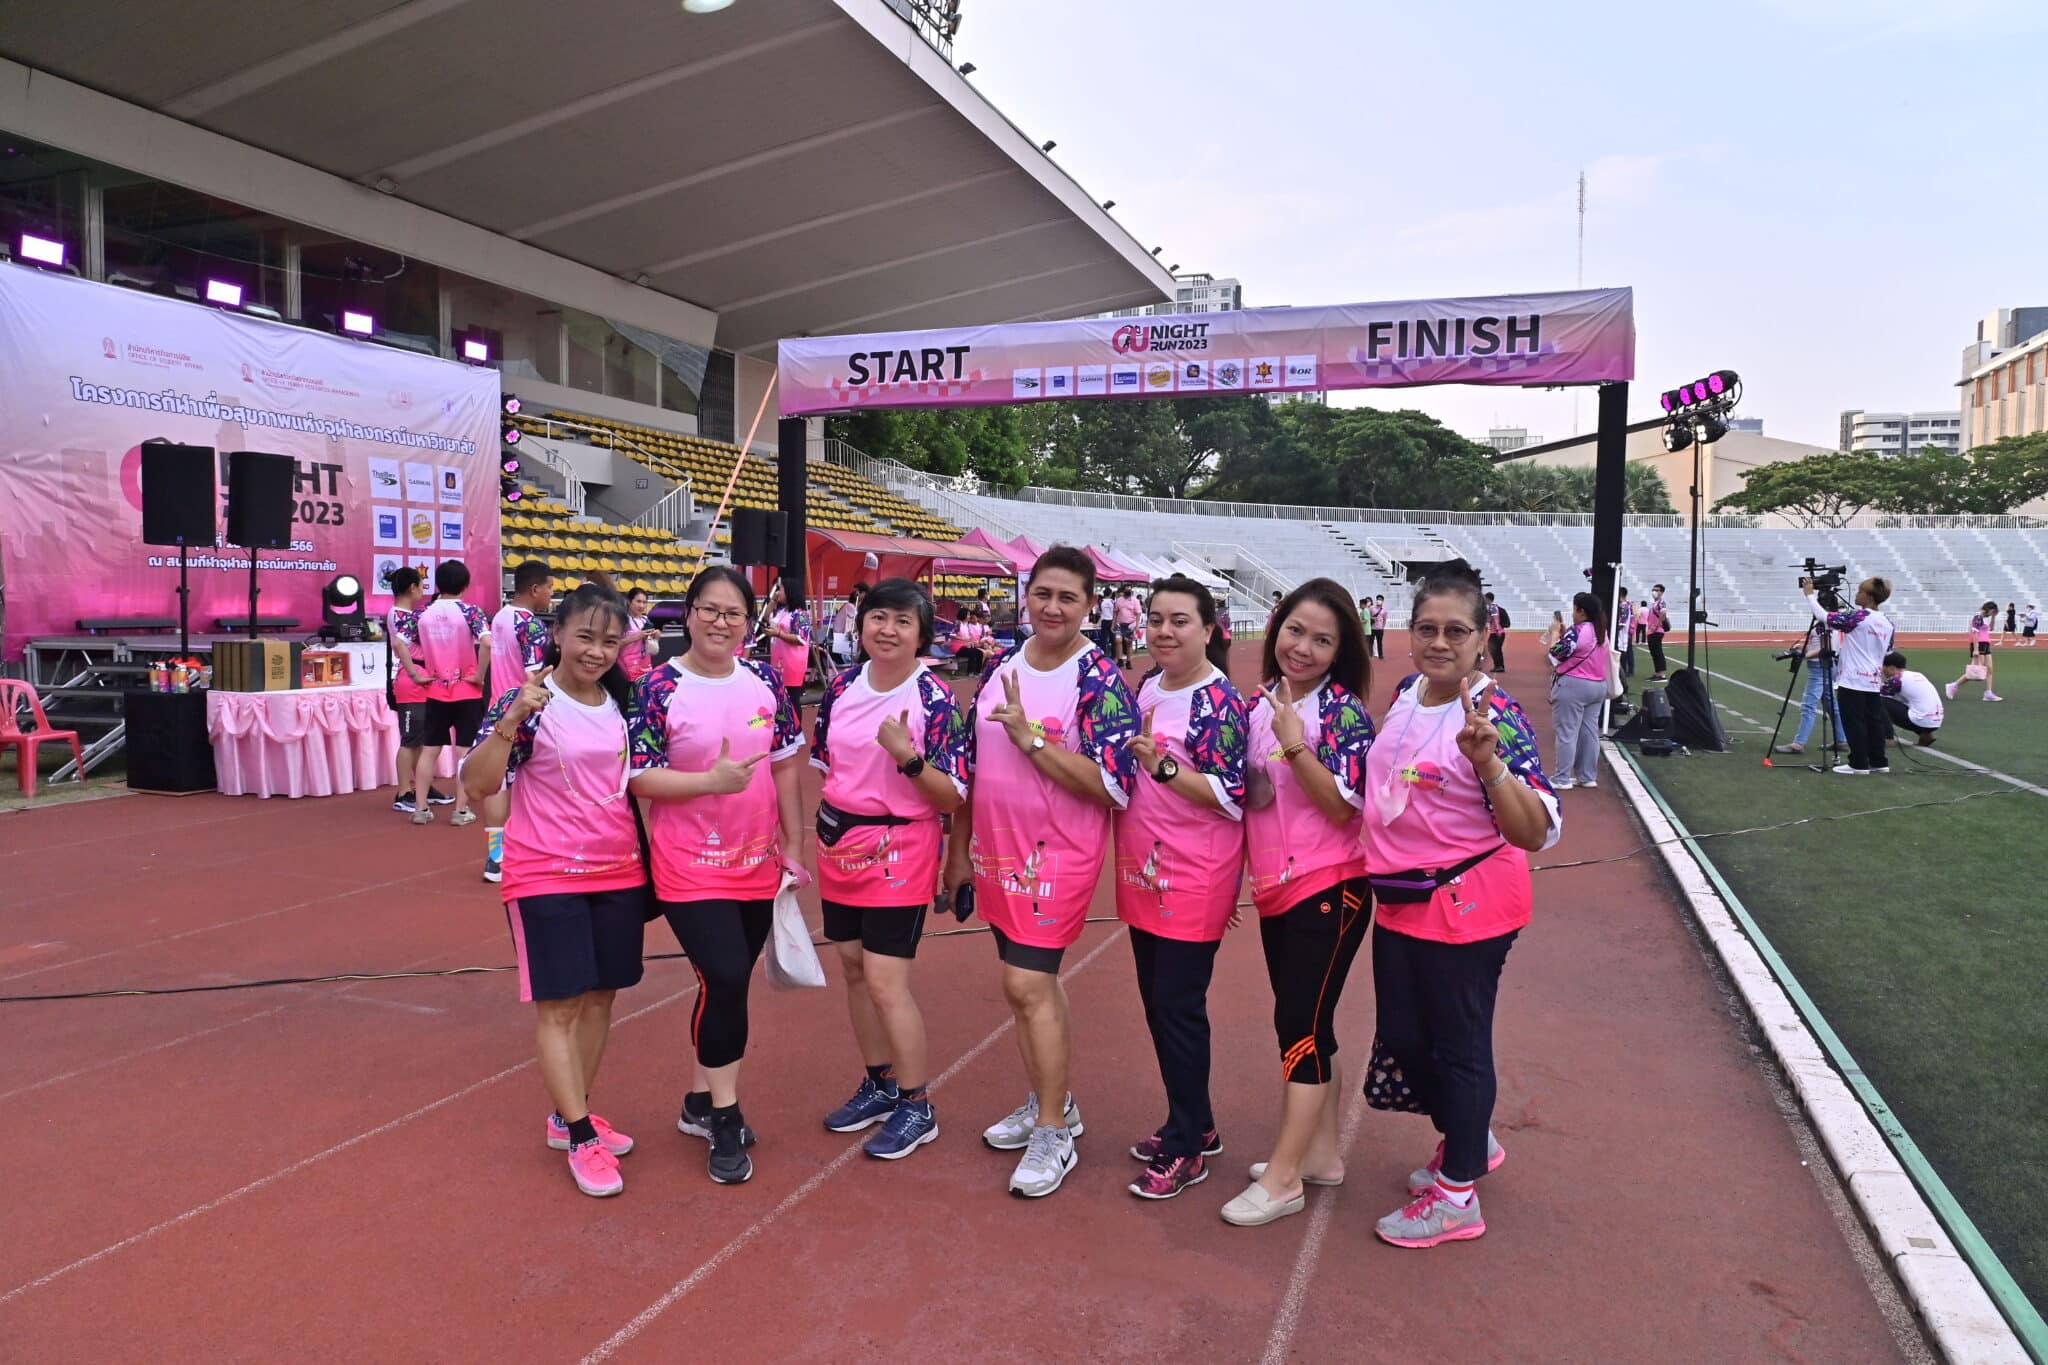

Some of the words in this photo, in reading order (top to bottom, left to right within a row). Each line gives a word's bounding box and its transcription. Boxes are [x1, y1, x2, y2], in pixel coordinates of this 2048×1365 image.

[1150, 323, 1209, 339] NIGHT
[1368, 315, 1540, 360] FINISH
[847, 345, 970, 385] START
[148, 555, 163, 567] ณ
